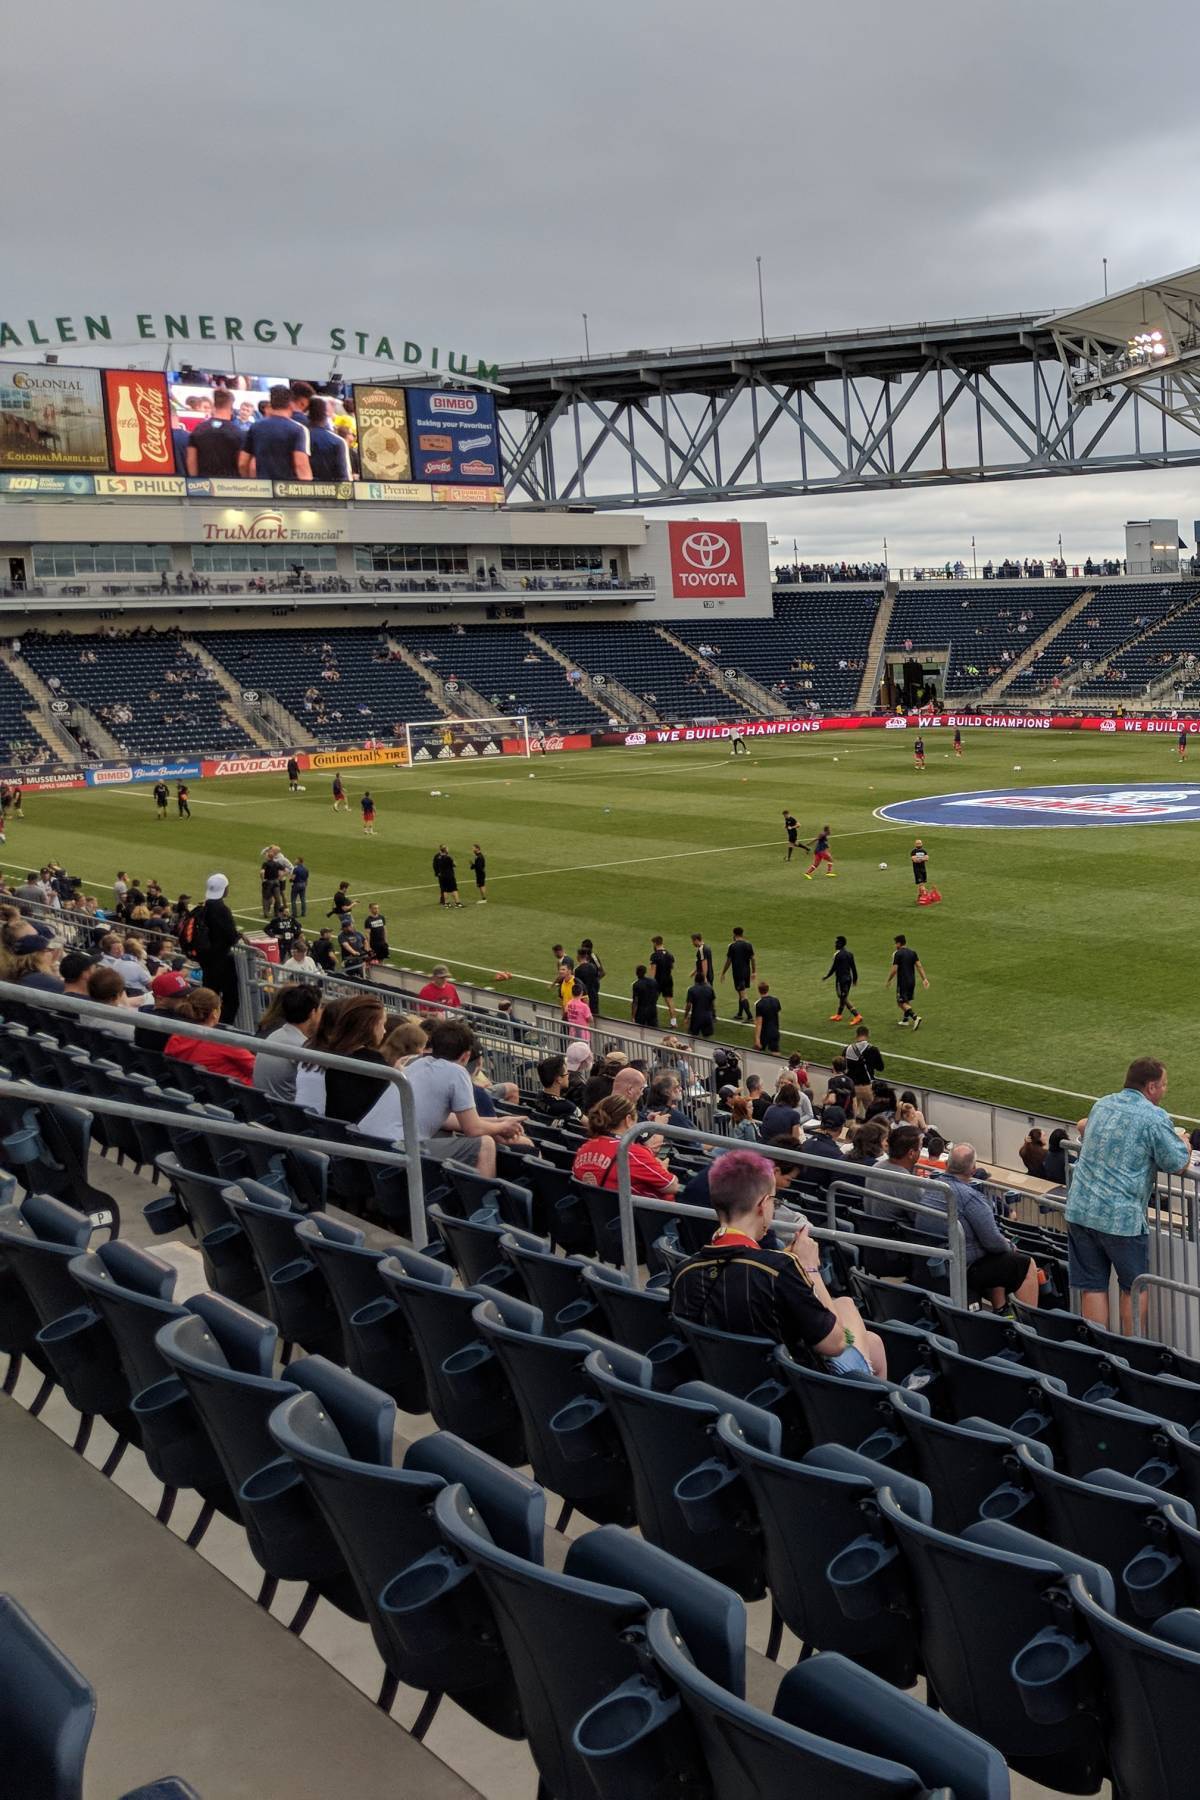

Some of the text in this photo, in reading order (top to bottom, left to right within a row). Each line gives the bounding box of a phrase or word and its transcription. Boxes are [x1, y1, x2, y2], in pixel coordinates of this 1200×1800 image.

[137, 314, 303, 345] ENERGY
[329, 328, 500, 383] STADIUM
[434, 397, 474, 409] BIMBO
[359, 408, 387, 416] SCOOP
[360, 416, 404, 429] DOOP
[417, 419, 492, 430] Baking your Favorites!
[134, 480, 184, 493] PHILLY
[289, 485, 336, 496] ACTION NEWS
[384, 483, 419, 495] Premier
[204, 523, 340, 540] TruMark Financial
[679, 573, 738, 586] TOYOTA
[919, 718, 1050, 728] WE BUILD CHAMPIONS
[1124, 722, 1141, 731] WE
[1147, 723, 1185, 732] BUILD
[657, 732, 679, 741] WE
[313, 754, 373, 767] Continental
[385, 751, 407, 759] TIRE
[215, 759, 287, 774] ADVOCAR
[27, 773, 85, 784] MUSSELMAN'S
[96, 772, 131, 781] BIMBO
[985, 797, 1172, 815] BIMBO
